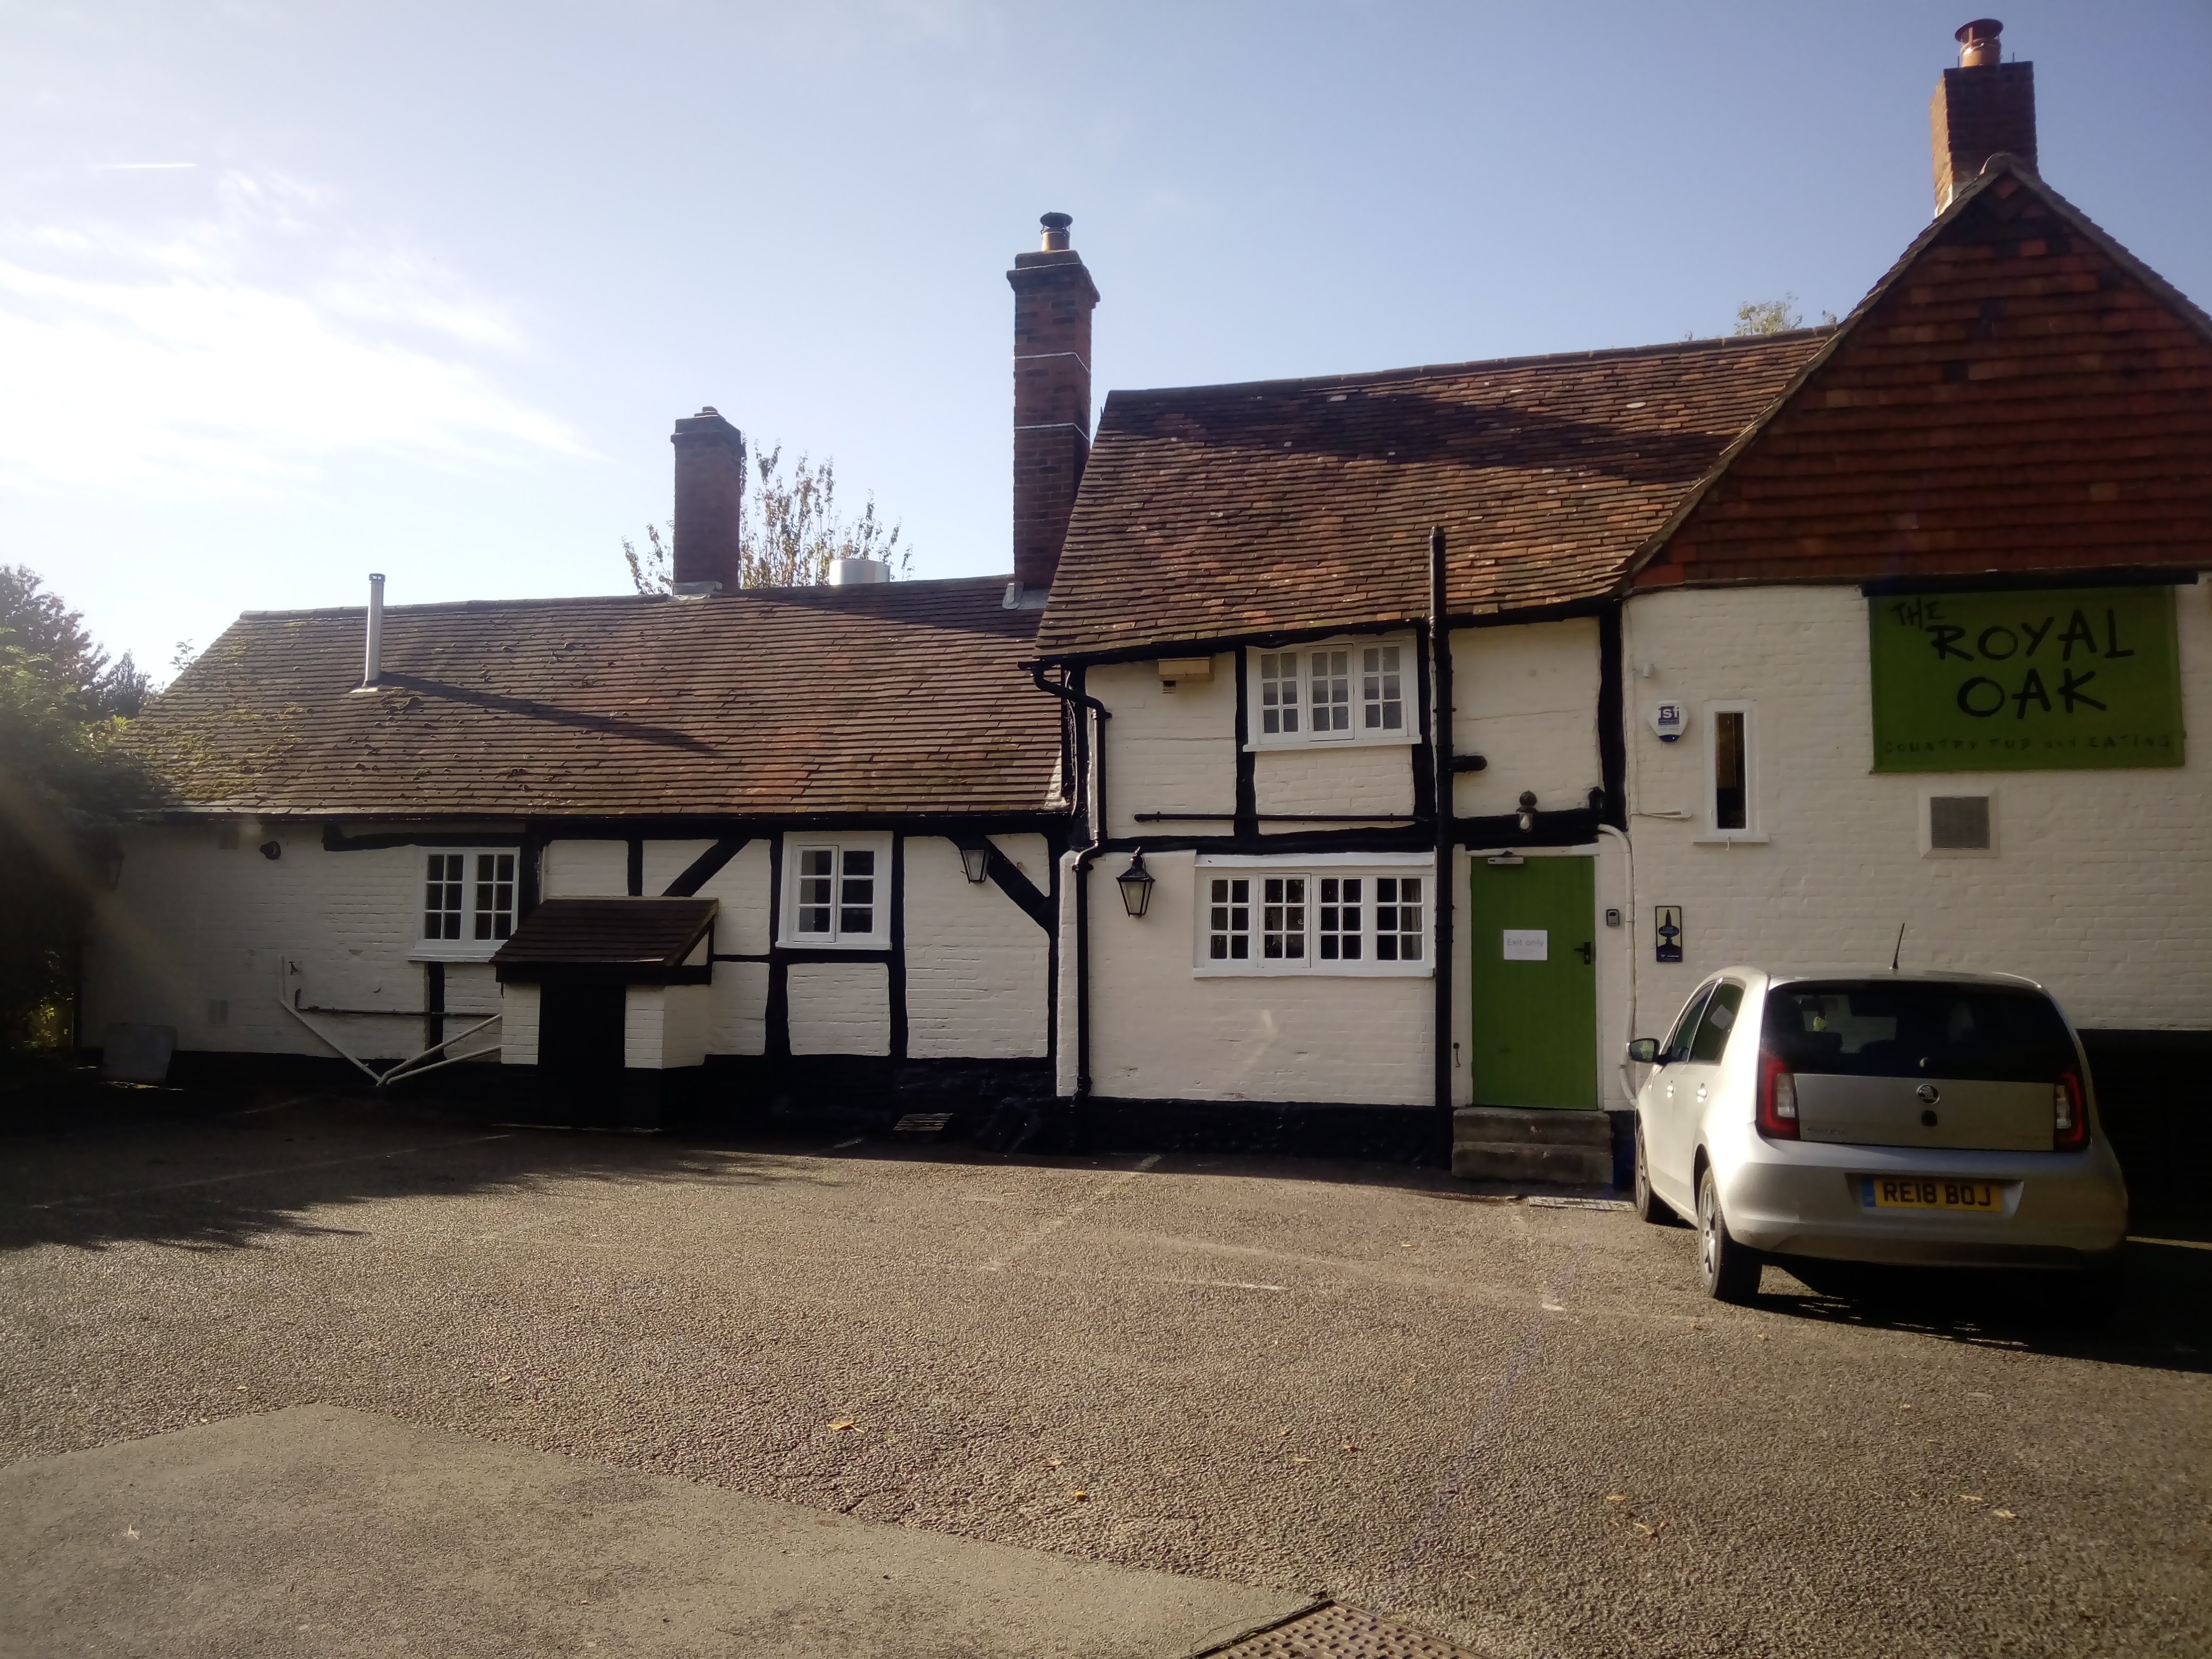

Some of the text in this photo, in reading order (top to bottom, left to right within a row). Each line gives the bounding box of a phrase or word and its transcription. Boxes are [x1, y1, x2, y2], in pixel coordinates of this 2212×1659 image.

[1890, 596, 1946, 630] THE
[1925, 608, 2134, 662] ROYAL
[1957, 668, 2107, 719] OAK
[1525, 938, 1544, 948] only
[1882, 1182, 1938, 1203] RE18
